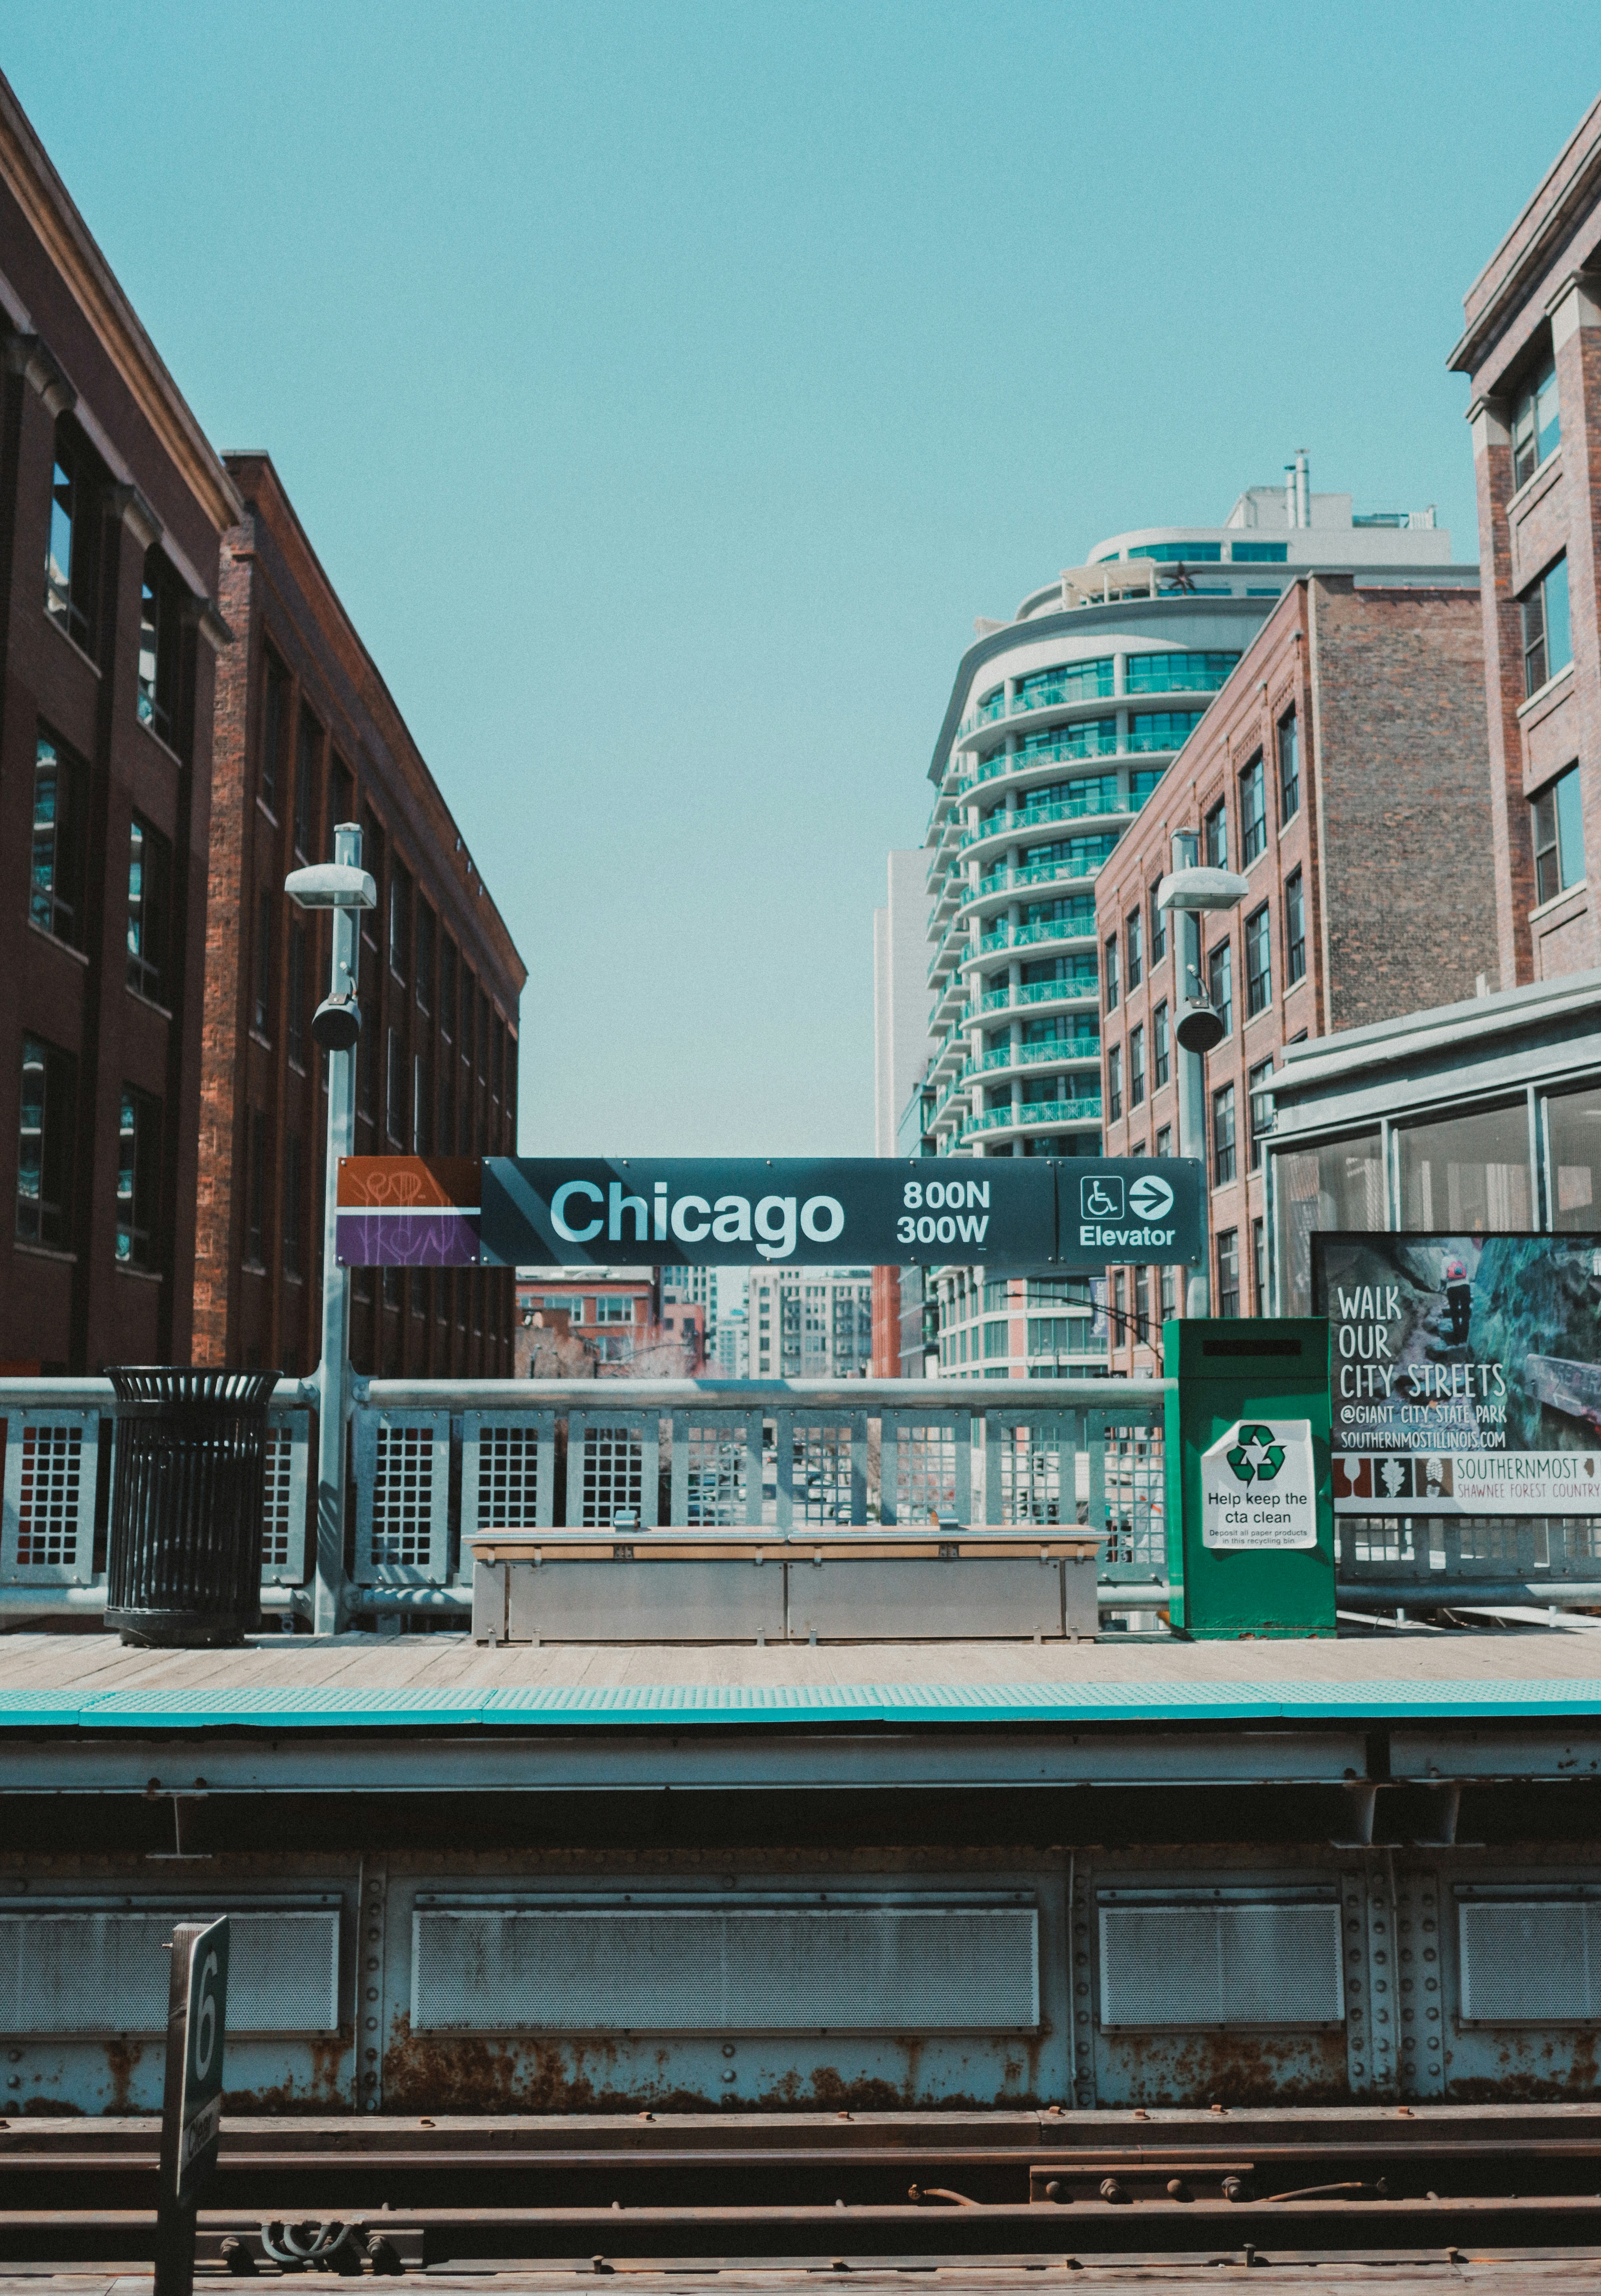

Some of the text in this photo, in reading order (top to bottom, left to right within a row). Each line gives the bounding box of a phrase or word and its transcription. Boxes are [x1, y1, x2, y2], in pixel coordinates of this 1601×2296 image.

[903, 1181, 990, 1209] 800N
[550, 1181, 845, 1259] Chicago
[897, 1215, 989, 1243] 300W
[1080, 1226, 1175, 1246] Elevator
[1337, 1285, 1401, 1320] WALK
[1339, 1324, 1392, 1359] OUR
[1341, 1363, 1506, 1398] CITY STREETS
[1341, 1404, 1507, 1424] @GIANT CITY STATE PARK
[1341, 1431, 1506, 1448] SOUTHERNMOSTILLINOIS.COM
[1458, 1458, 1578, 1479] SOUTHERNMOST
[1208, 1493, 1307, 1508] Help keep the
[1458, 1483, 1600, 1498] SHAWNEE FOREST COUNTRY
[1225, 1511, 1291, 1523] cta clean
[196, 1949, 217, 2081] 6
